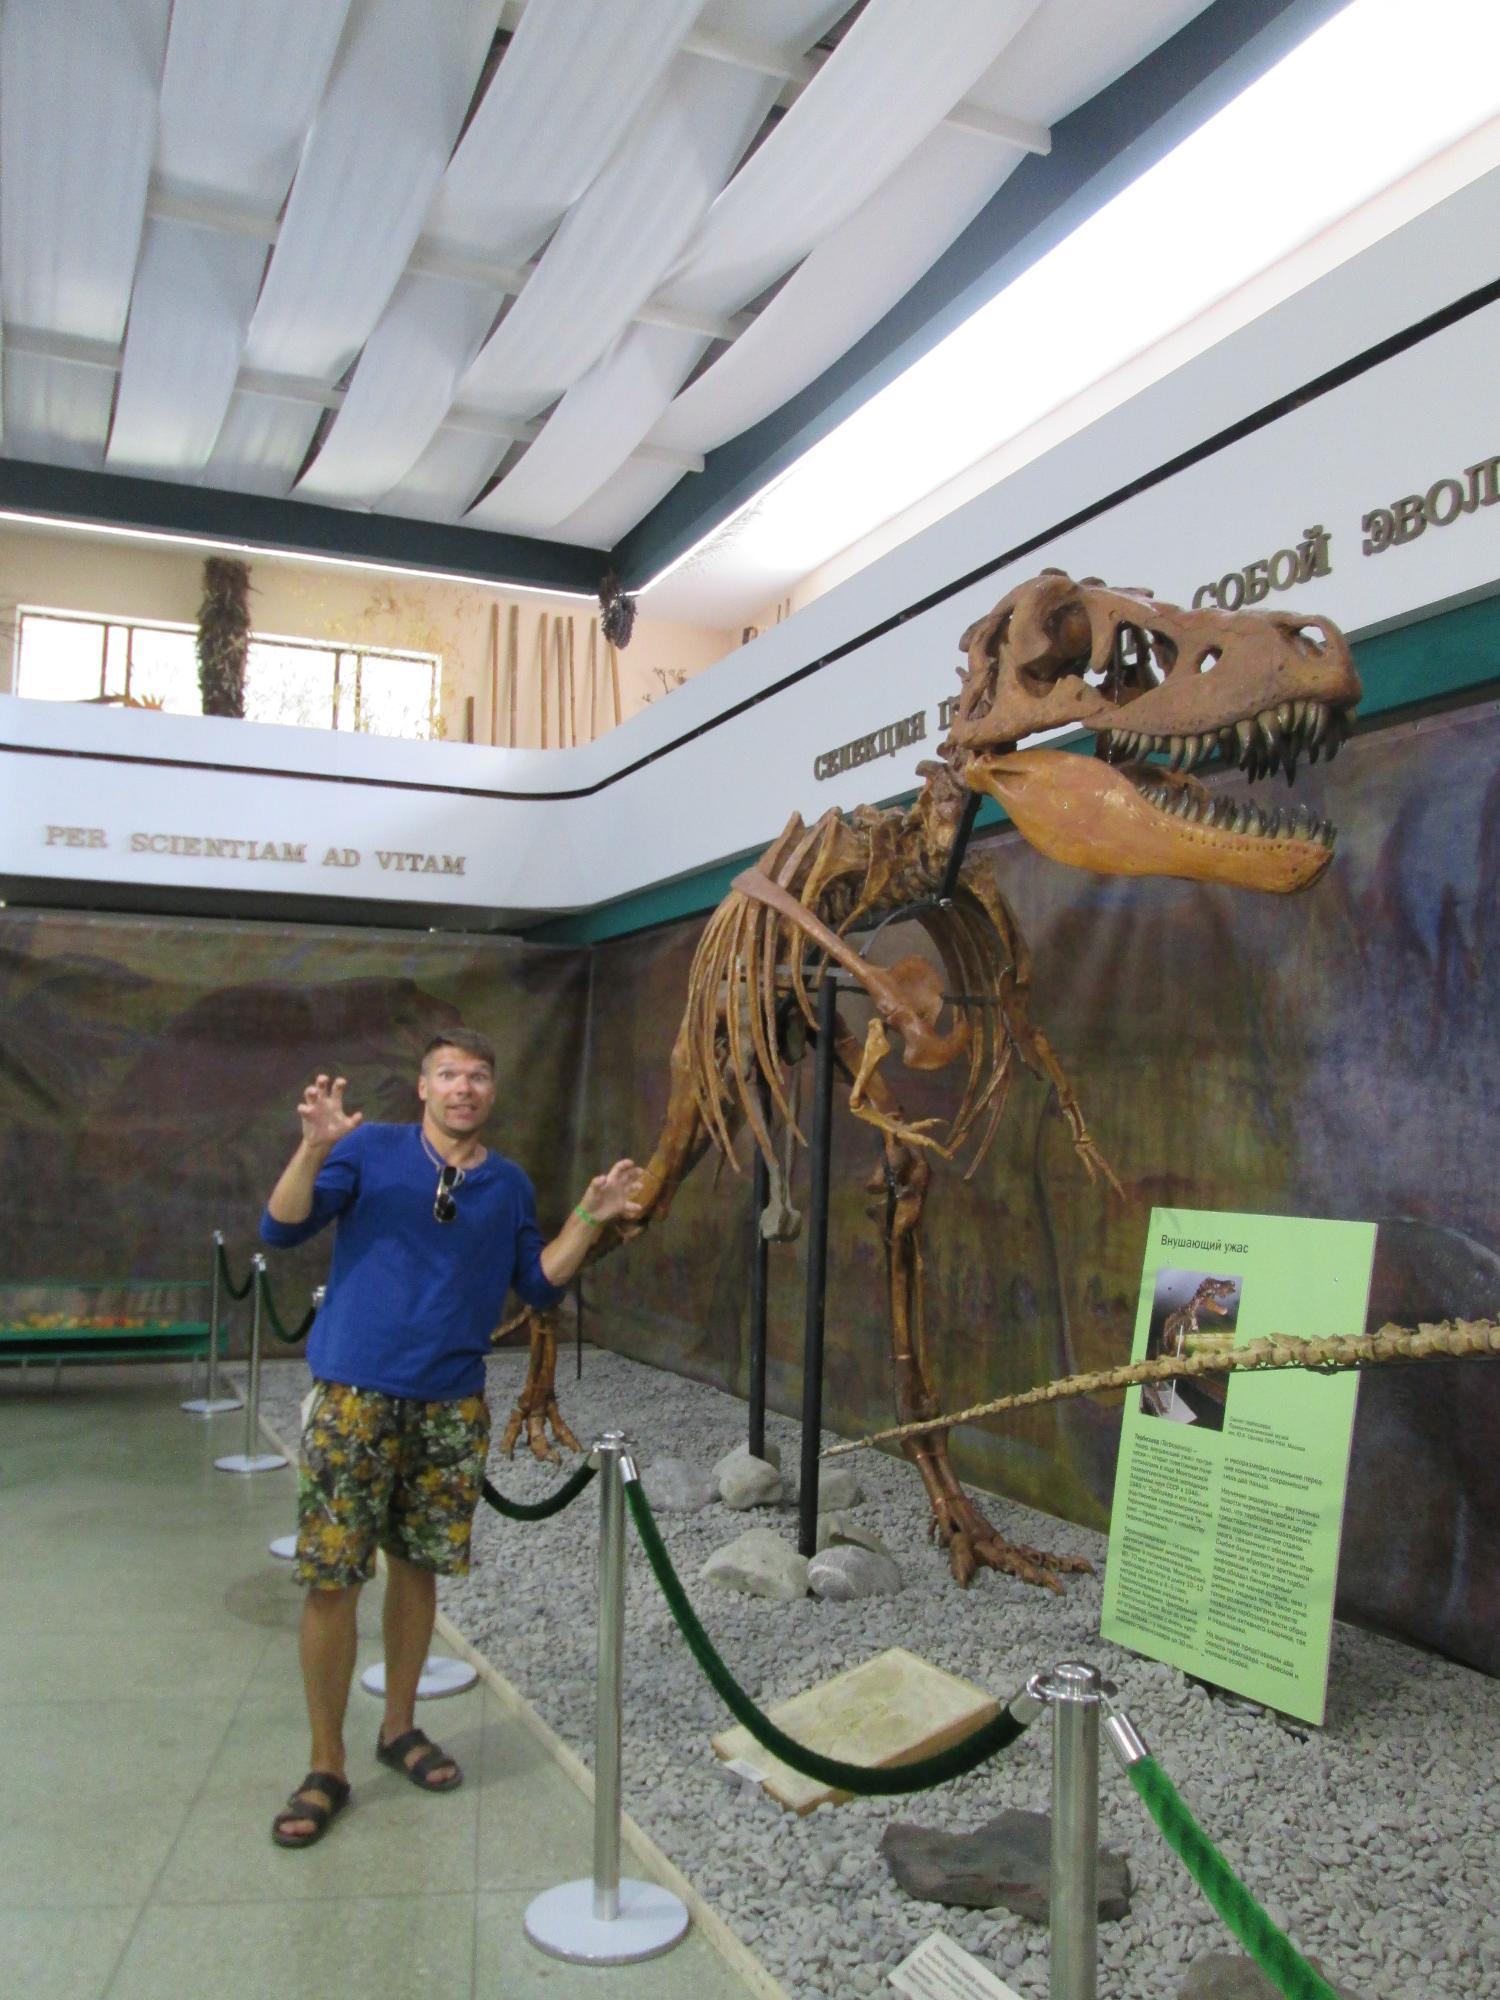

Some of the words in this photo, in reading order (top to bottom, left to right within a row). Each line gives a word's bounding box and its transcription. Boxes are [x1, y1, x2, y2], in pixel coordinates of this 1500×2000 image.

[814, 710, 927, 781] СЕЛЕКЦИЯ
[1192, 524, 1332, 611] СОБОЙ
[1362, 455, 1500, 557] ЭВОЛ
[45, 826, 108, 849] PER
[130, 832, 307, 863] SCIENTIAM
[322, 847, 361, 867] AD
[374, 850, 467, 875] VITAM
[1161, 1234, 1222, 1251] Внушающий
[1224, 1242, 1248, 1254] ужас
